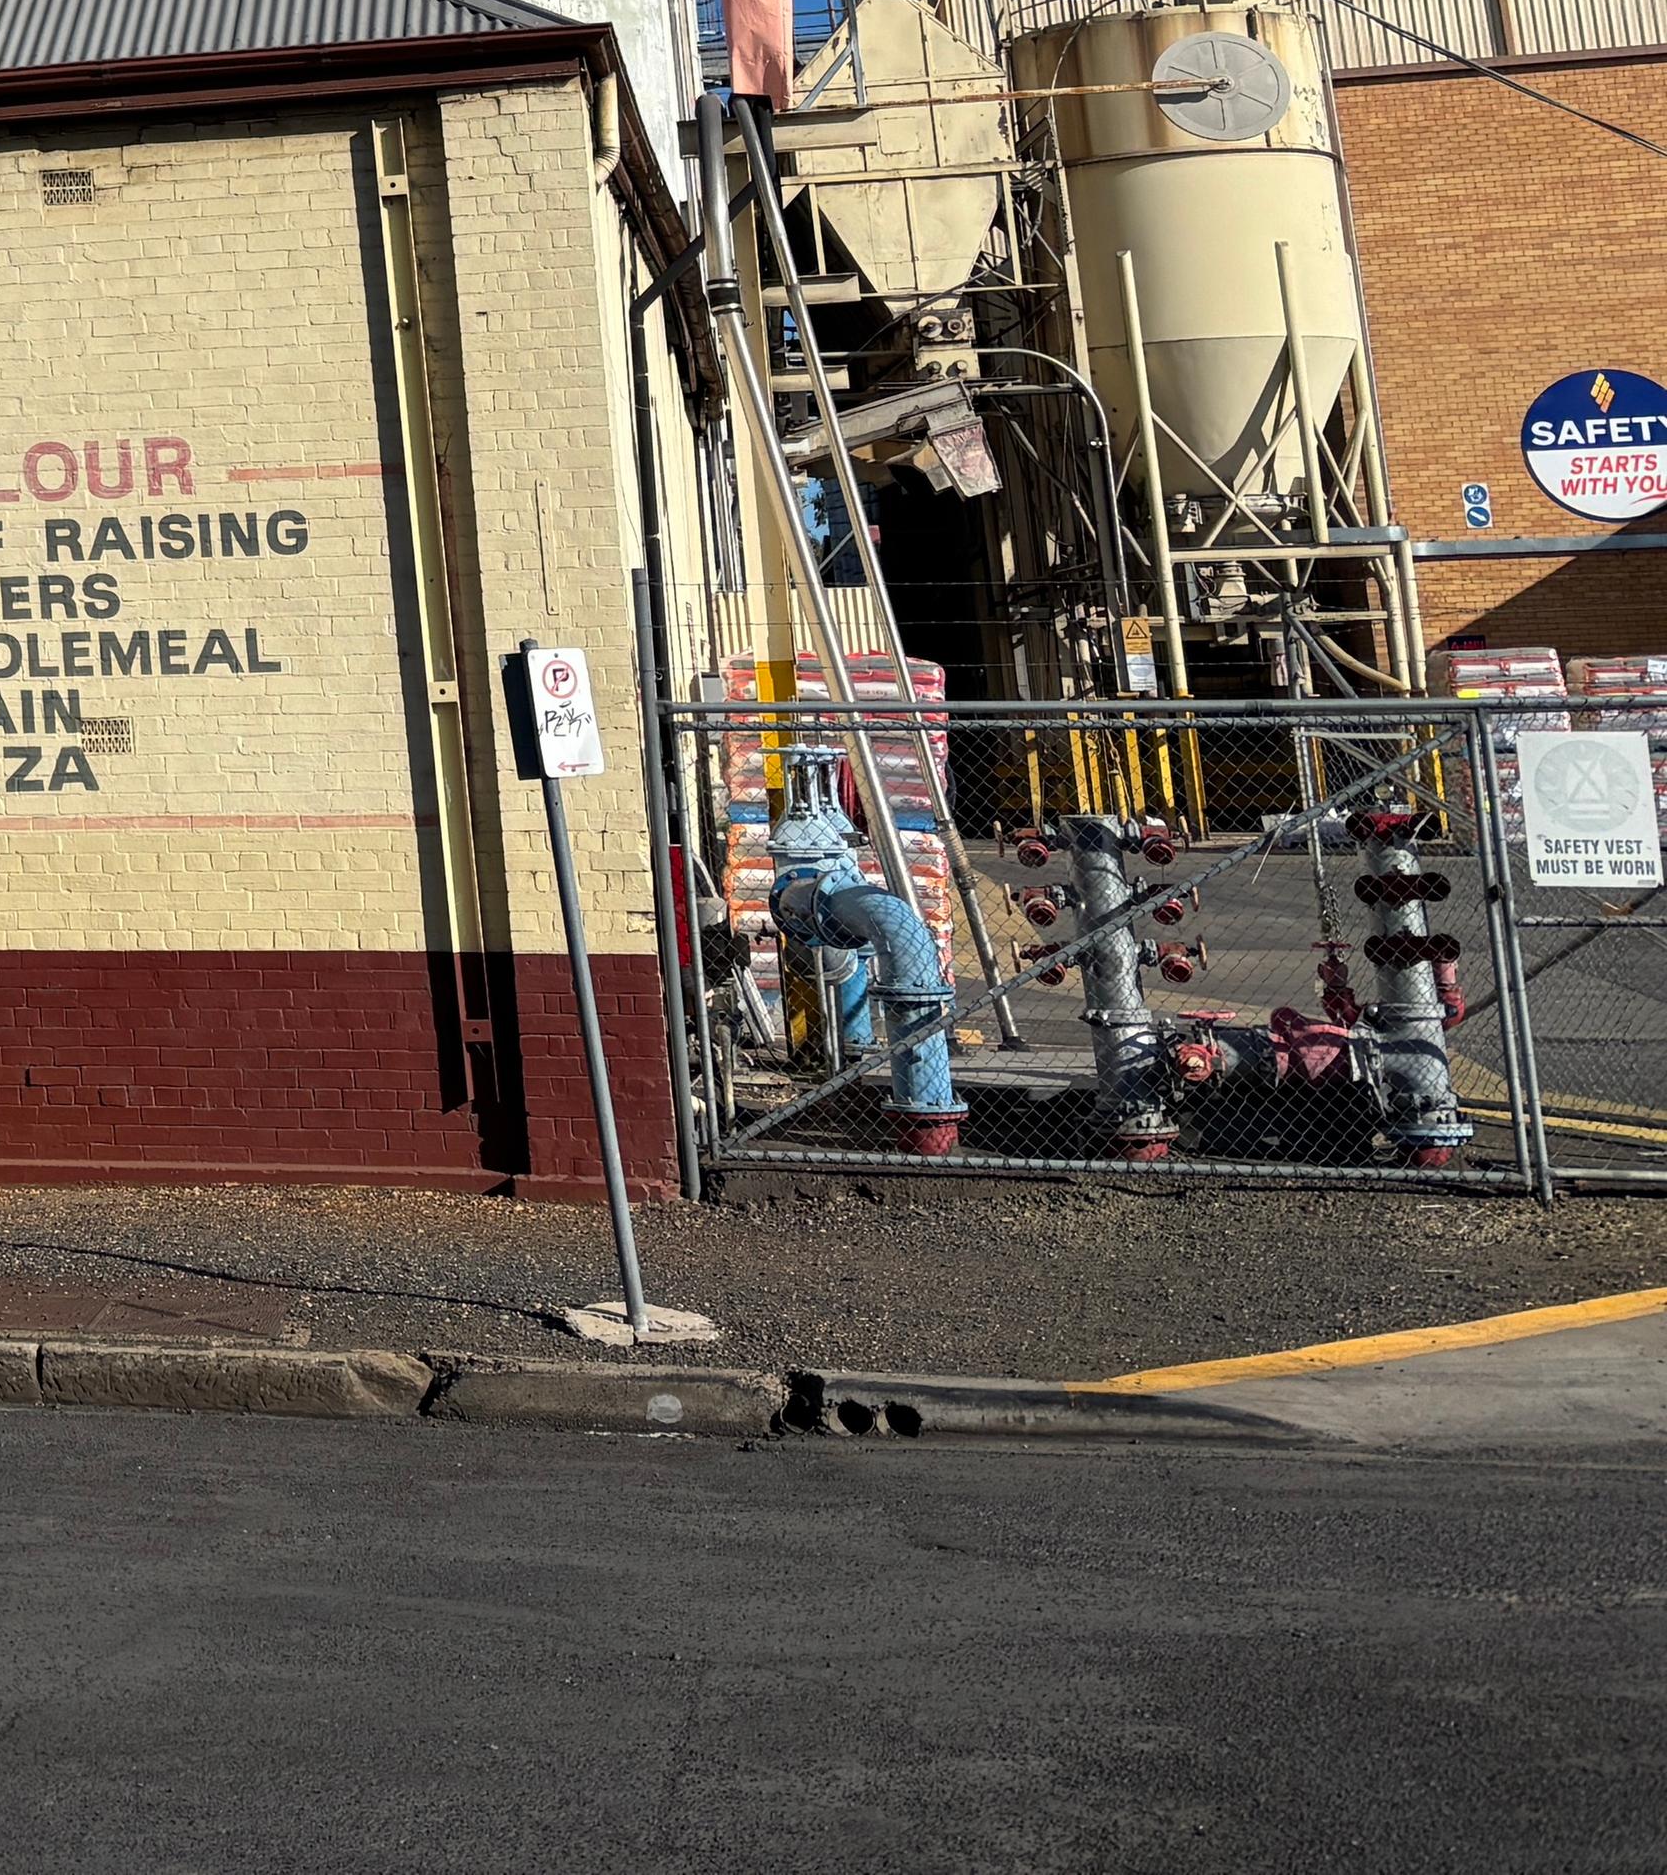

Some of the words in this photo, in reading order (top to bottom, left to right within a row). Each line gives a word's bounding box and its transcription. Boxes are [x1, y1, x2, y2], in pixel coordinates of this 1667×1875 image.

[1570, 454, 1658, 475] STARTS
[1561, 478, 1617, 497] WITH
[1625, 475, 1667, 494] YOU
[46, 510, 309, 563] RAISING
[552, 668, 569, 692] P
[1544, 839, 1599, 854] SAFETY
[1604, 839, 1643, 854] VEST
[1536, 859, 1579, 874] MUST
[1584, 860, 1604, 874] BE
[1609, 860, 1656, 875] WORN
